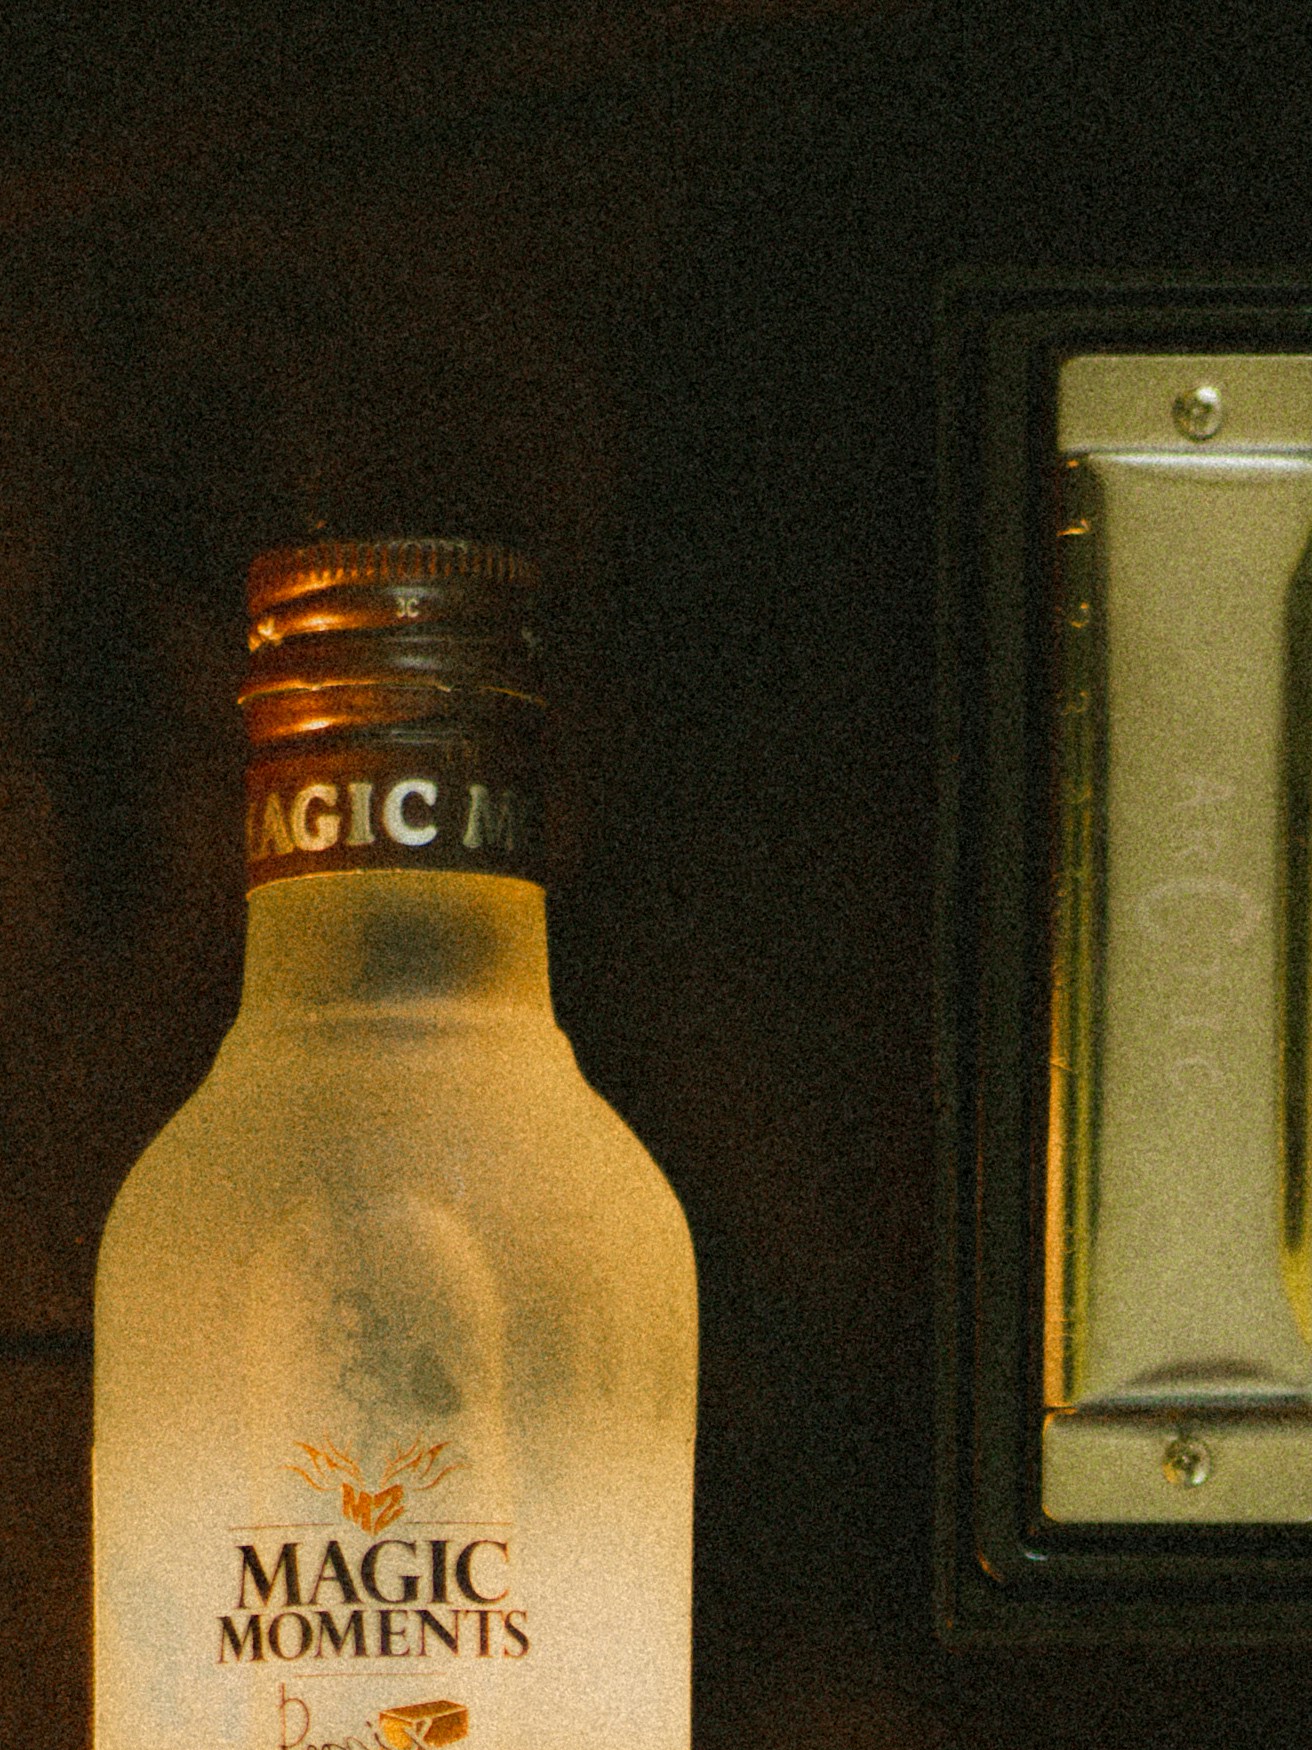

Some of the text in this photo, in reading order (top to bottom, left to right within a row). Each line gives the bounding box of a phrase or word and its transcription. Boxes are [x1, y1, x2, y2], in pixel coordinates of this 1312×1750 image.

[247, 777, 438, 860] AGIC
[235, 1539, 510, 1609] MAGIC
[216, 1609, 530, 1664] MOMENTS
